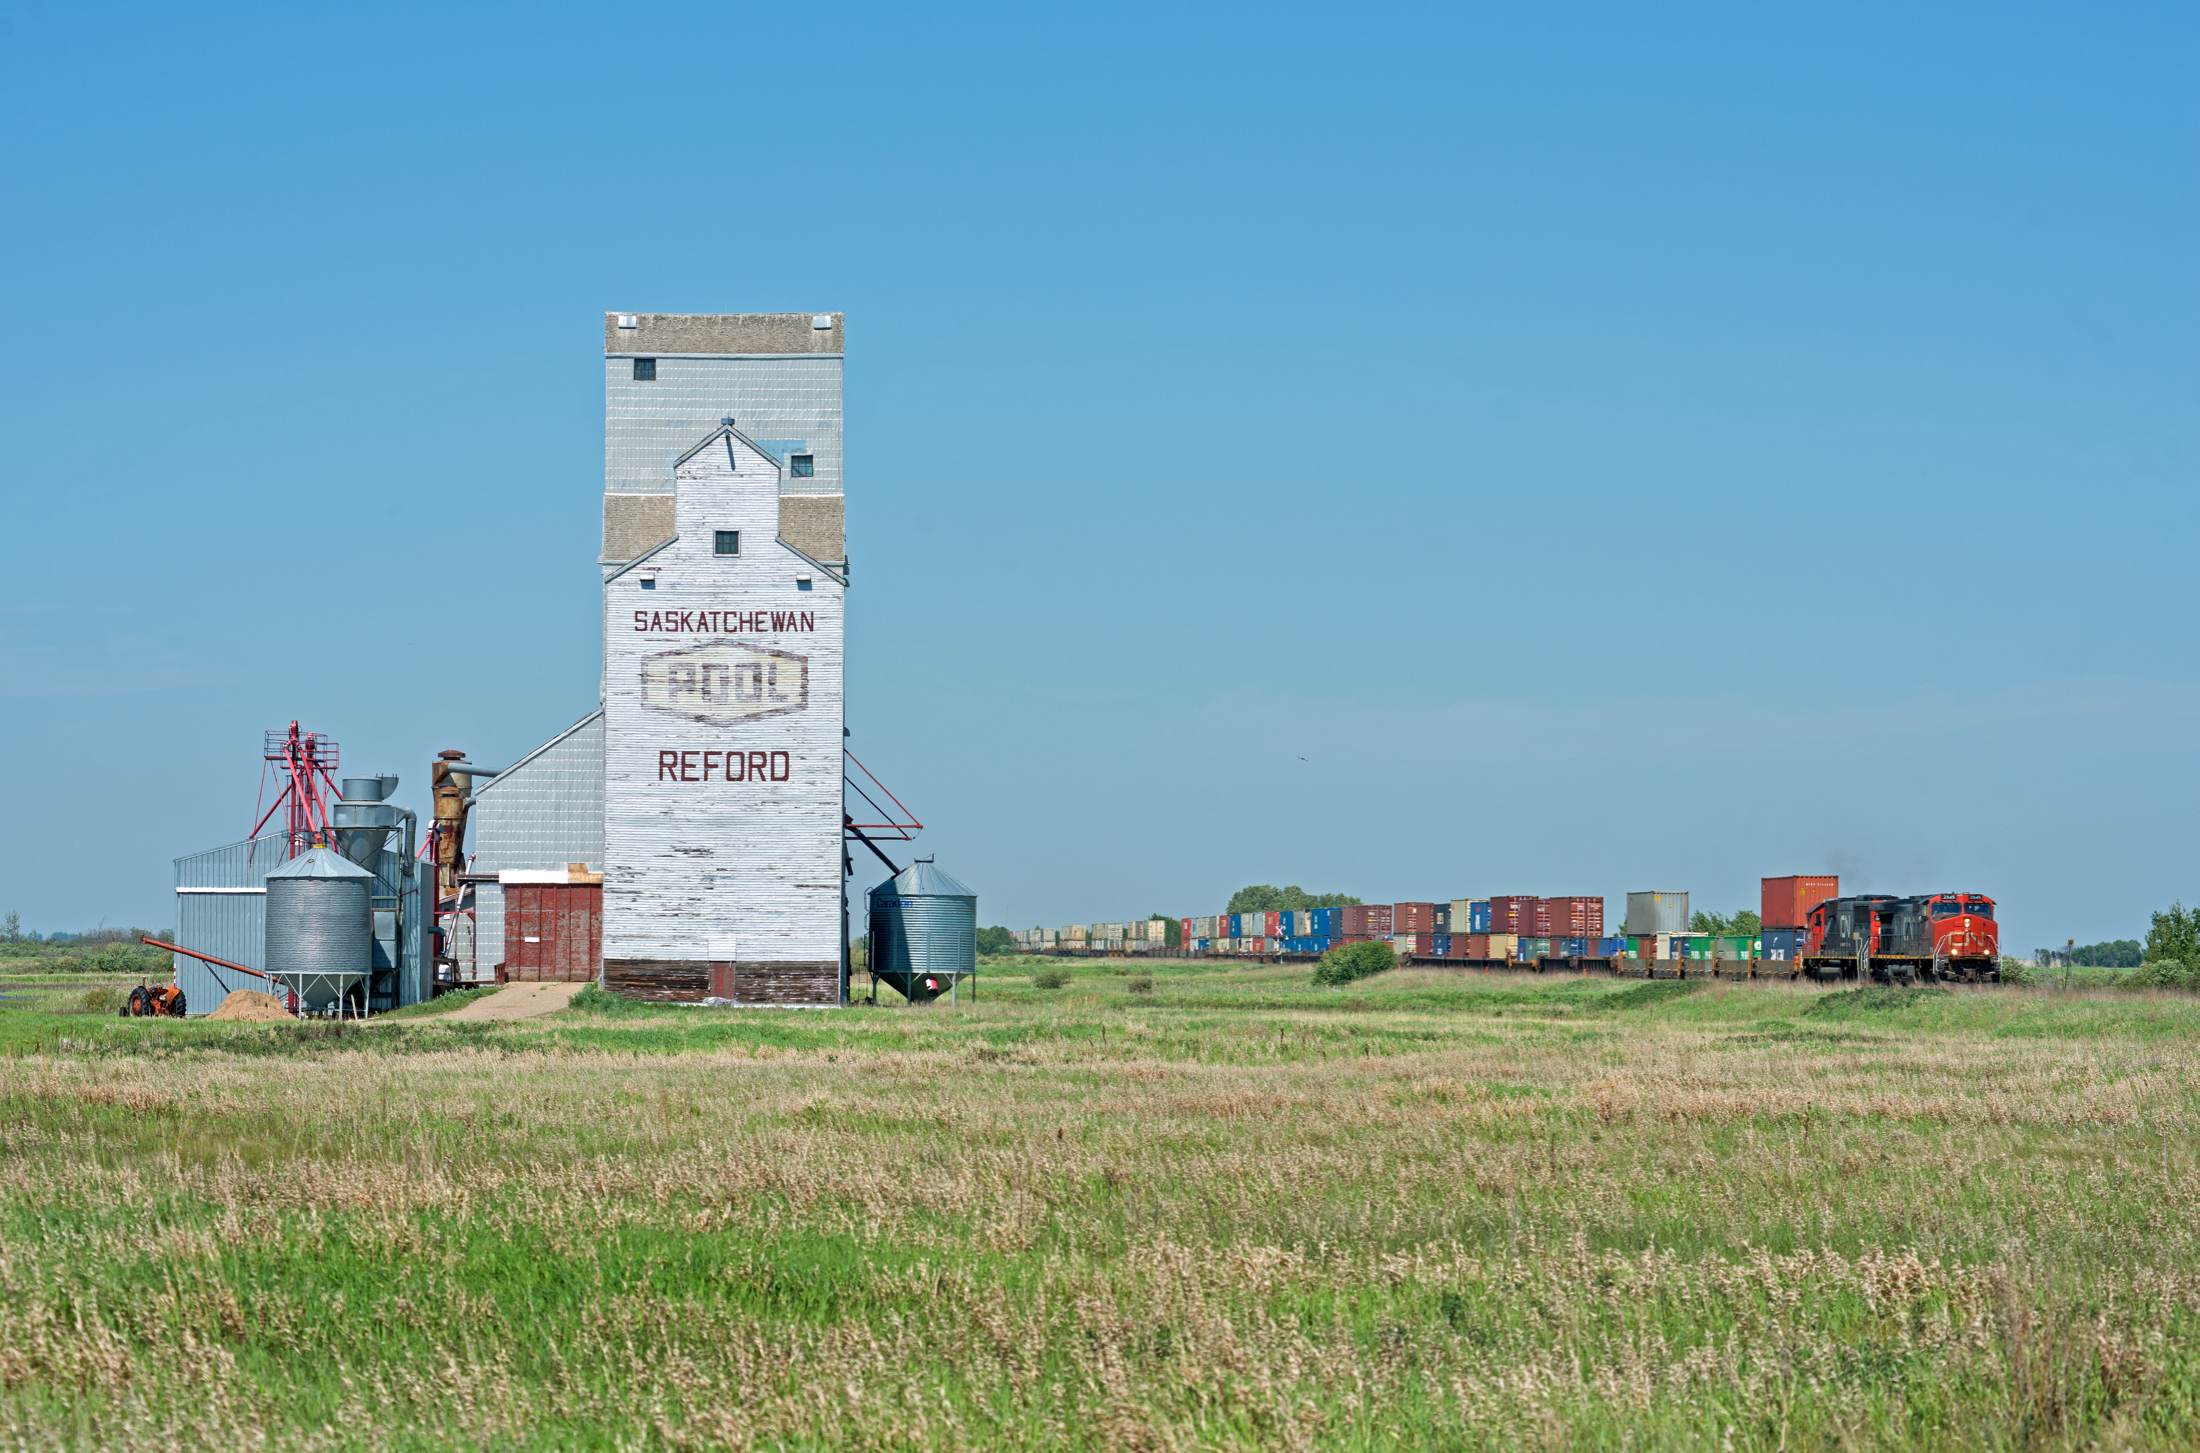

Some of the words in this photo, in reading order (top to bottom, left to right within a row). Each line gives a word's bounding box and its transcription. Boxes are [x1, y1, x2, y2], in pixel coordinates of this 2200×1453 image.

[635, 611, 814, 632] SASKATCHEWAN
[668, 662, 789, 702] POOL
[659, 751, 789, 781] REFORD
[1840, 915, 1850, 938] CN
[1948, 931, 1985, 946] CN
